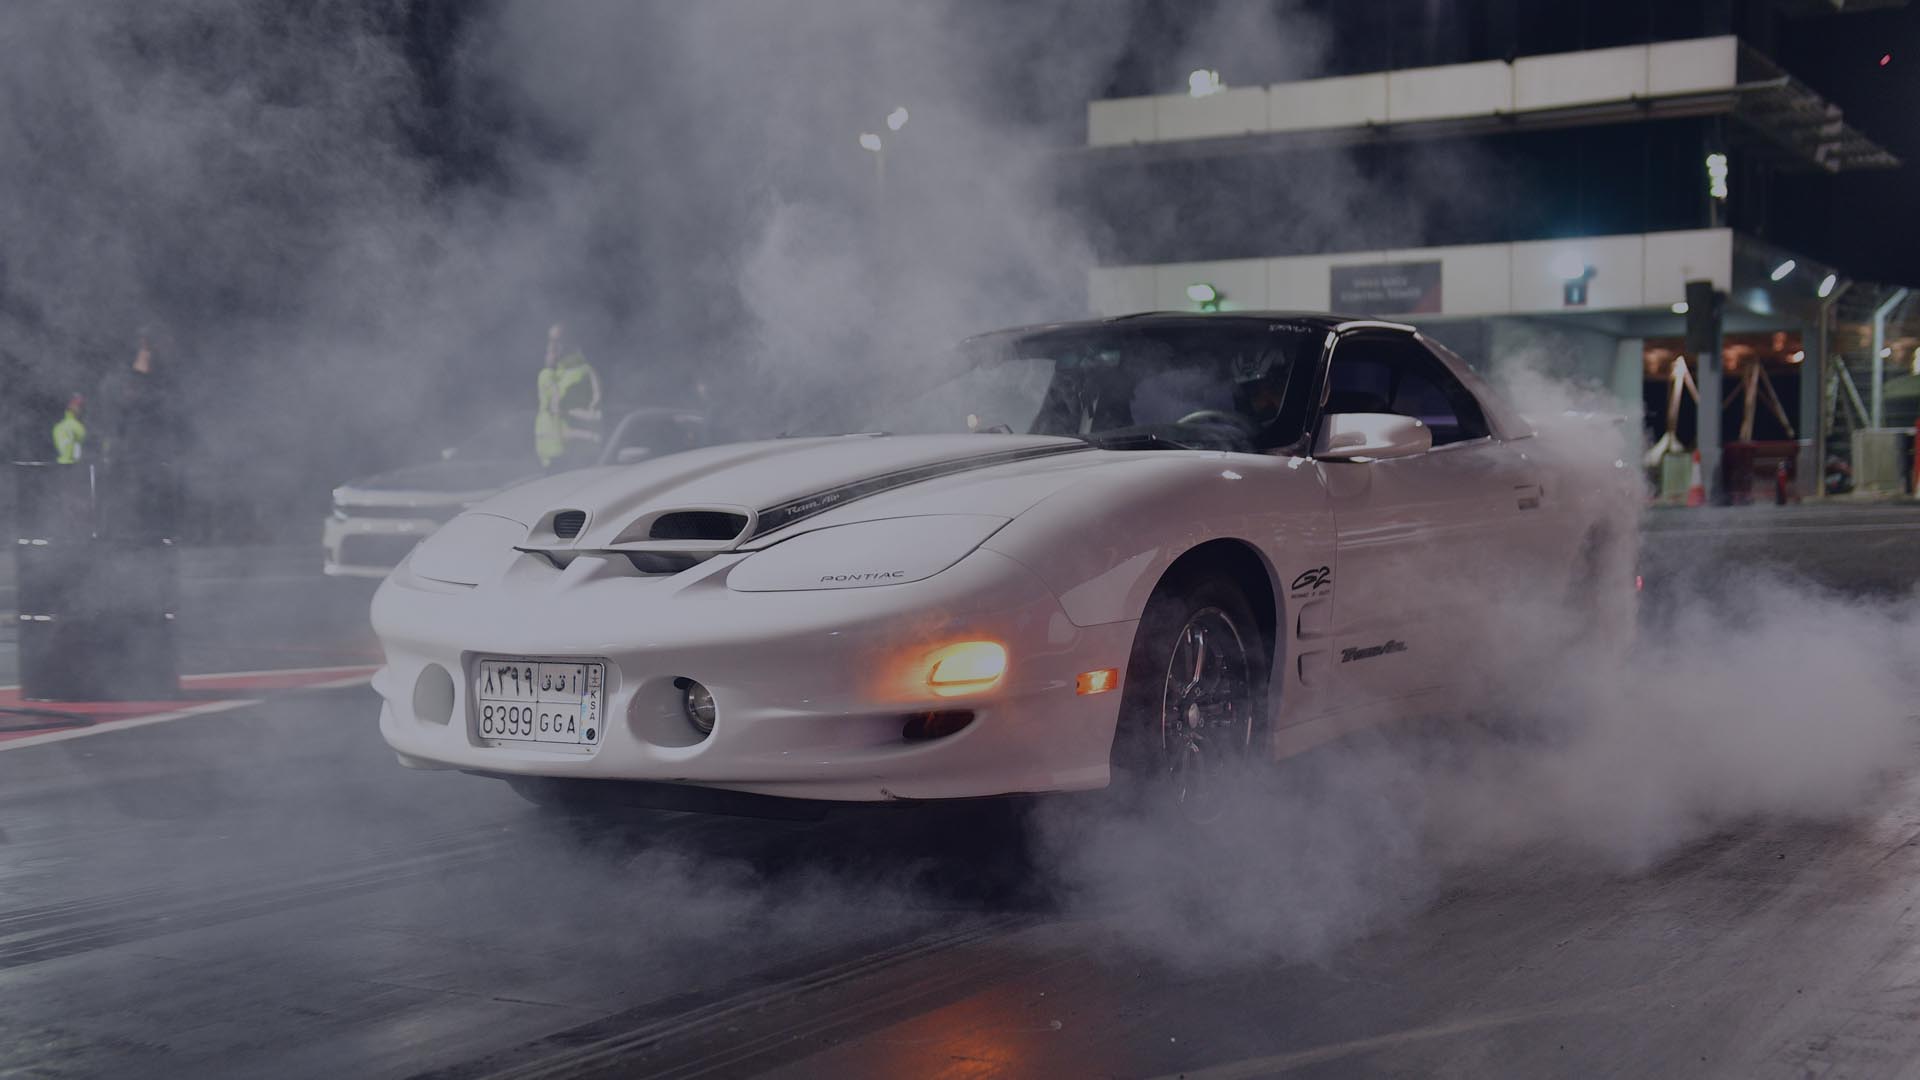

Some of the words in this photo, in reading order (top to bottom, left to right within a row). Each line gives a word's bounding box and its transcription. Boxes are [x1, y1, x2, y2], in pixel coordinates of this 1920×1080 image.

[820, 570, 905, 582] PONTIAC
[484, 665, 533, 697] ٨٣٩٩
[483, 705, 533, 736] 8399
[540, 712, 576, 735] GGA
